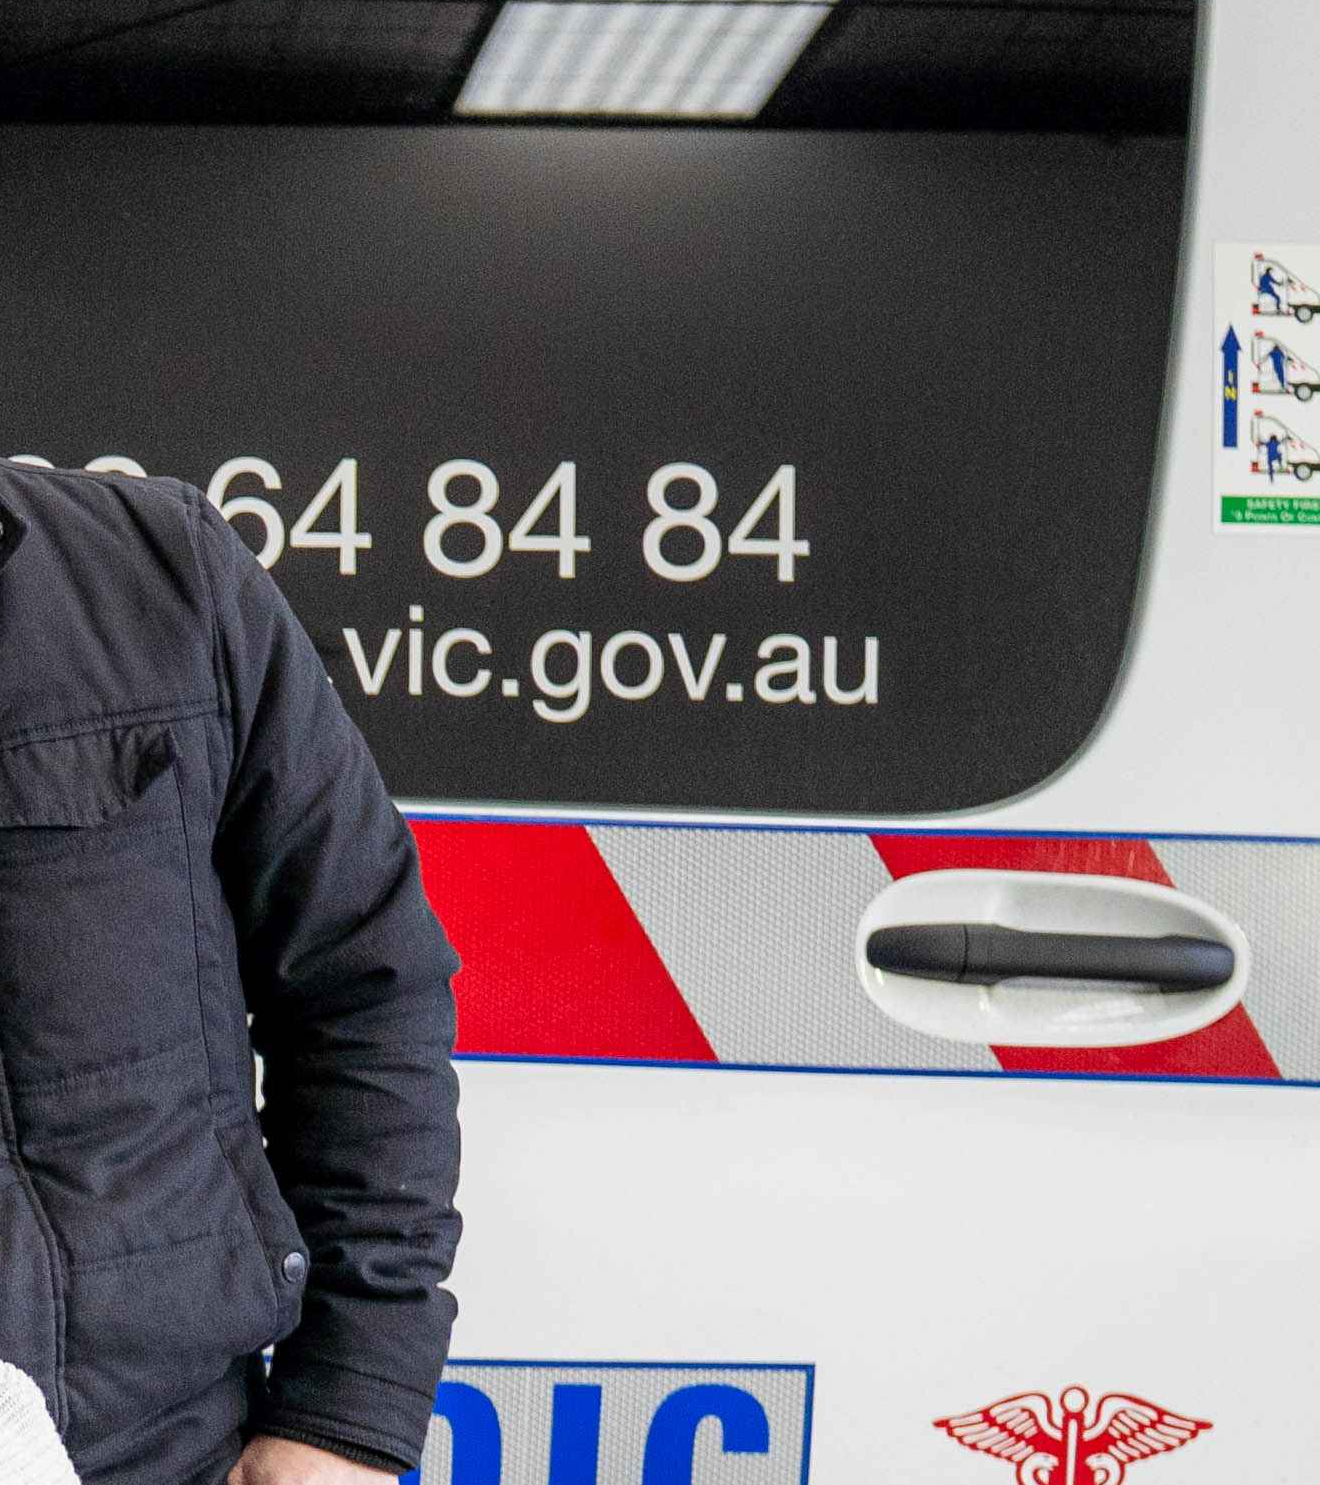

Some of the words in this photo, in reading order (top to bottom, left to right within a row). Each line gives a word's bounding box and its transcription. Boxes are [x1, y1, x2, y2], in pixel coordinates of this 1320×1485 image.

[206, 456, 373, 576] 64
[423, 458, 592, 579] 84
[642, 462, 812, 582] 84
[328, 604, 881, 722] vic.gov.au
